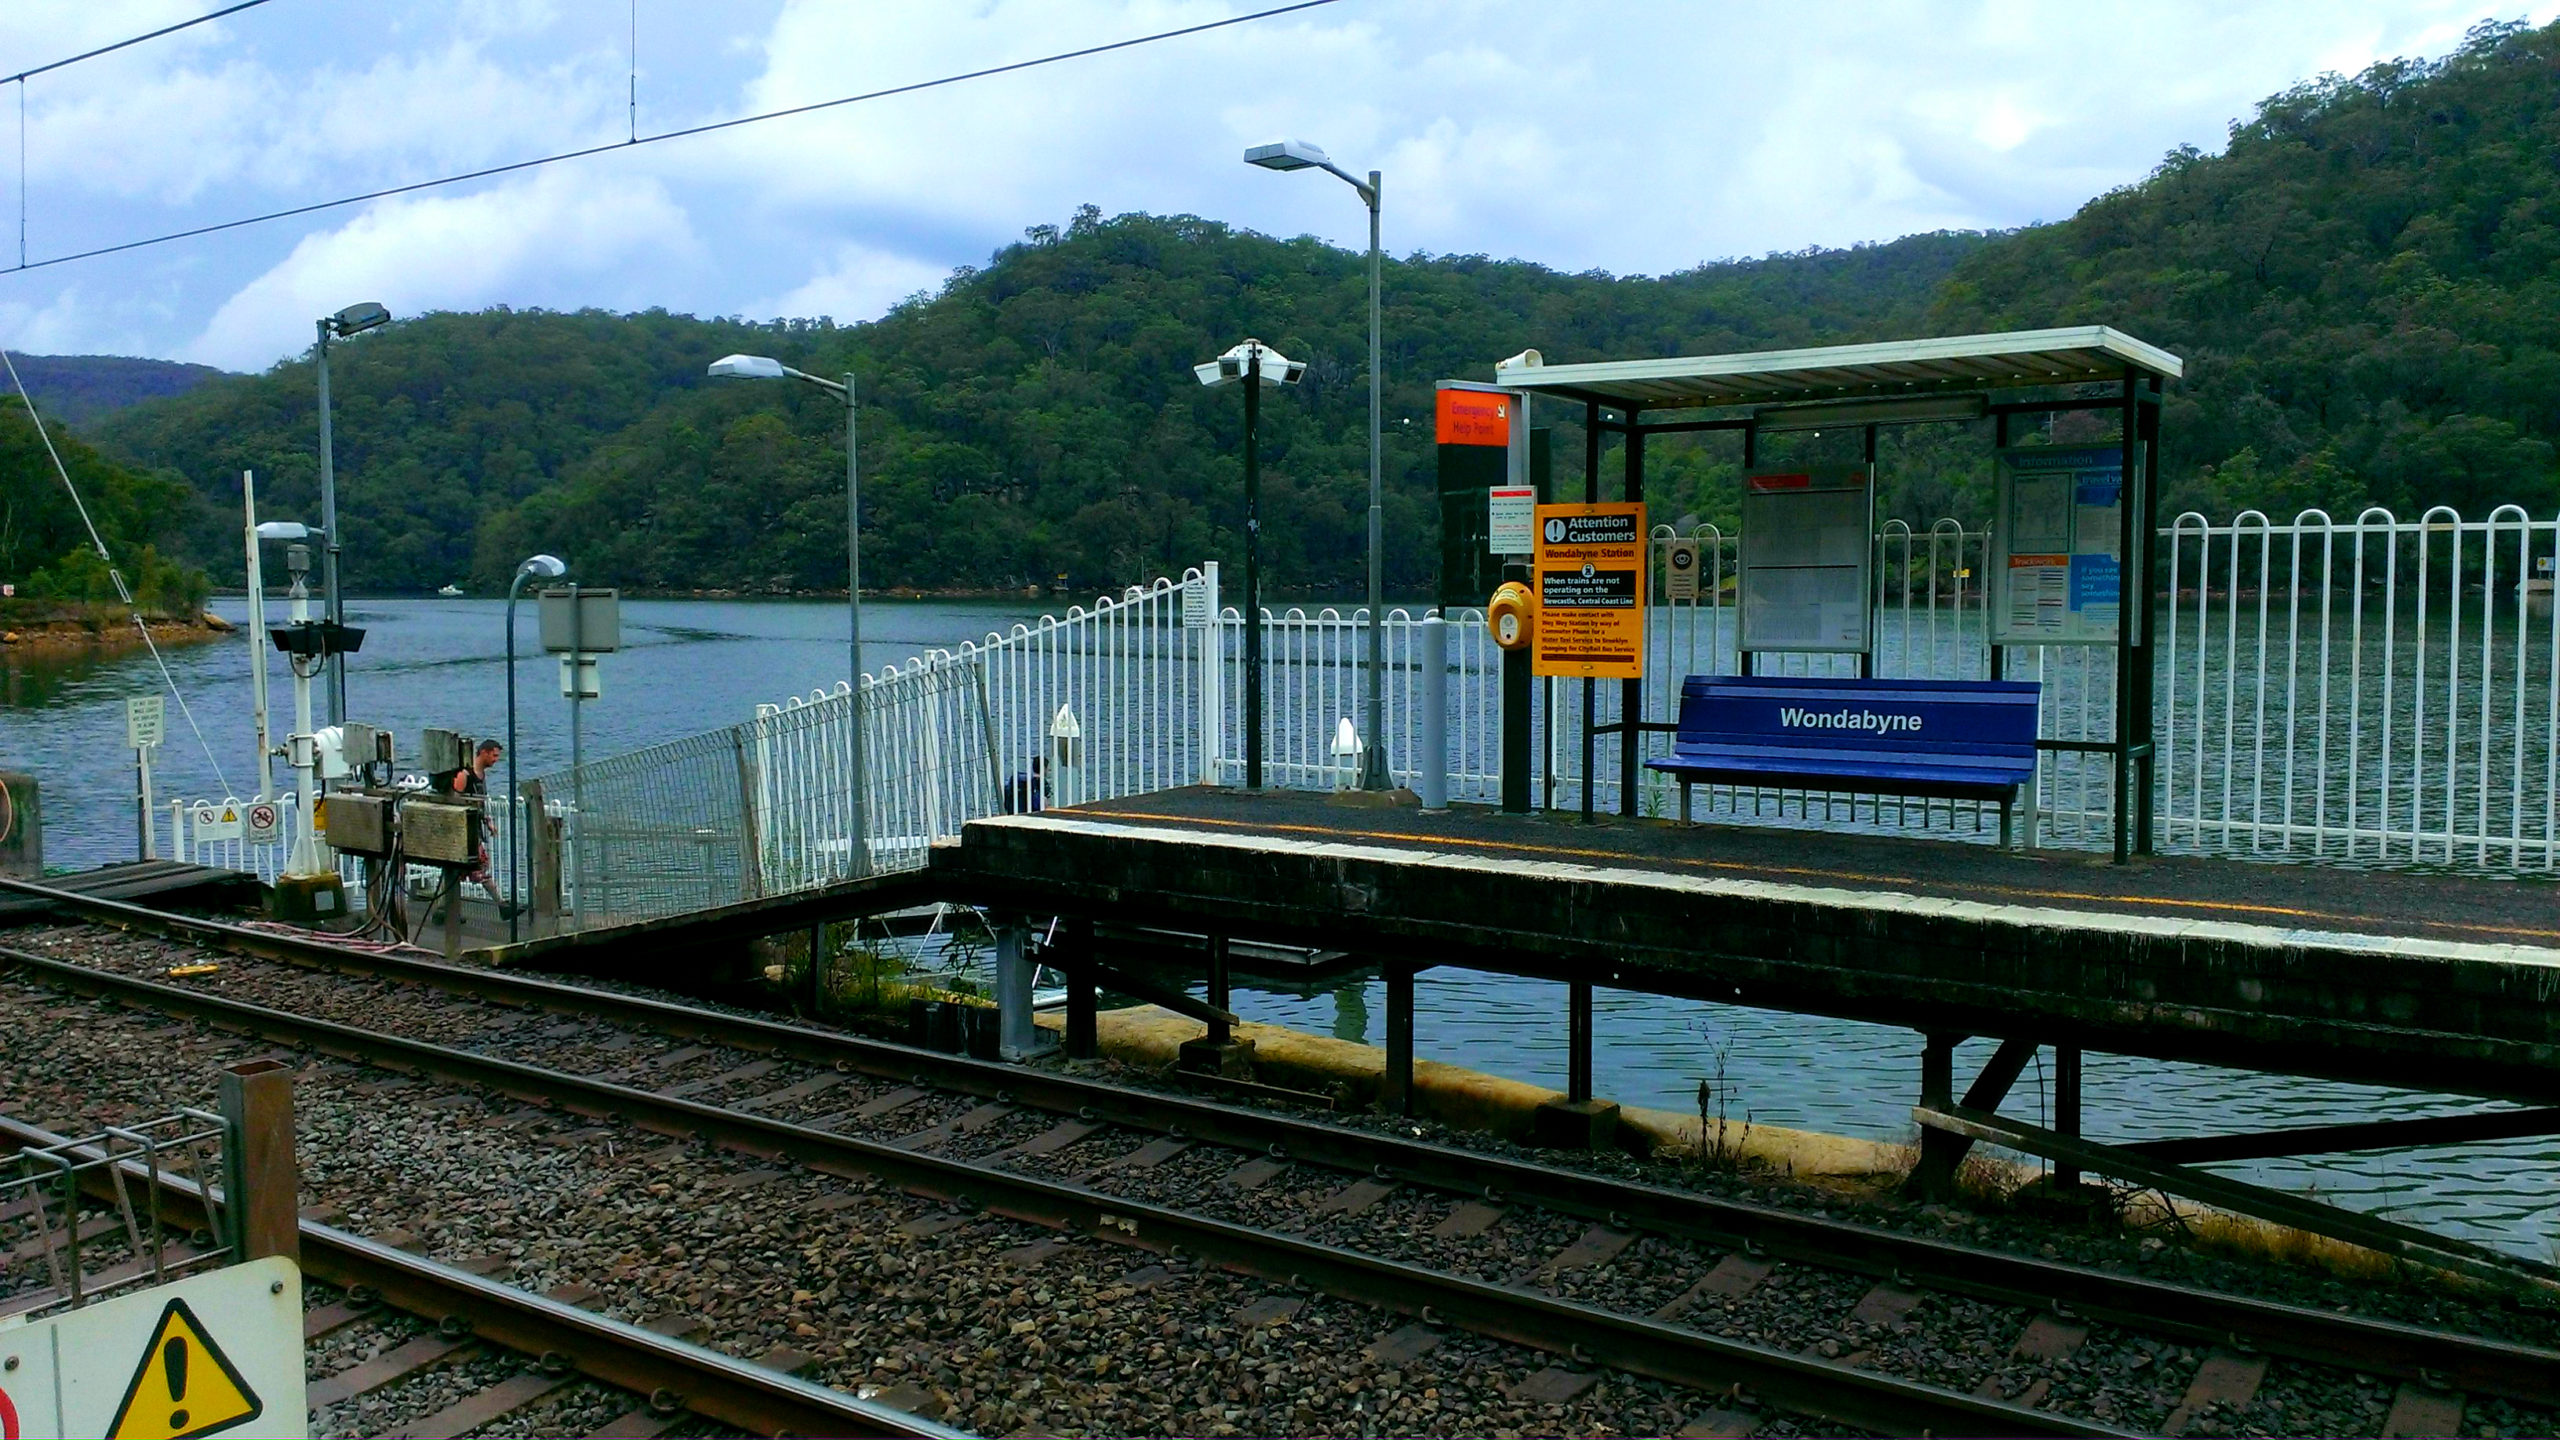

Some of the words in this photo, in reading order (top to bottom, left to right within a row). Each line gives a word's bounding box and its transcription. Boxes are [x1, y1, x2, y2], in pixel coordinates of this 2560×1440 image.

[1451, 401, 1494, 420] Emergency
[1453, 420, 1472, 437] Help
[1474, 421, 1494, 435] Point
[2019, 455, 2093, 468] Information
[1568, 516, 1629, 529] Attention
[1568, 530, 1636, 542] Customers
[1545, 548, 1599, 560] Wondabyne
[1601, 547, 1635, 558] Station
[1543, 577, 1566, 585] When
[1568, 577, 1590, 585] trains
[1606, 577, 1620, 585] not
[1544, 586, 1581, 595] operating
[1595, 586, 1609, 594] the
[1602, 637, 1628, 645] Brooklyn
[1780, 707, 1923, 735] Wondabyne
